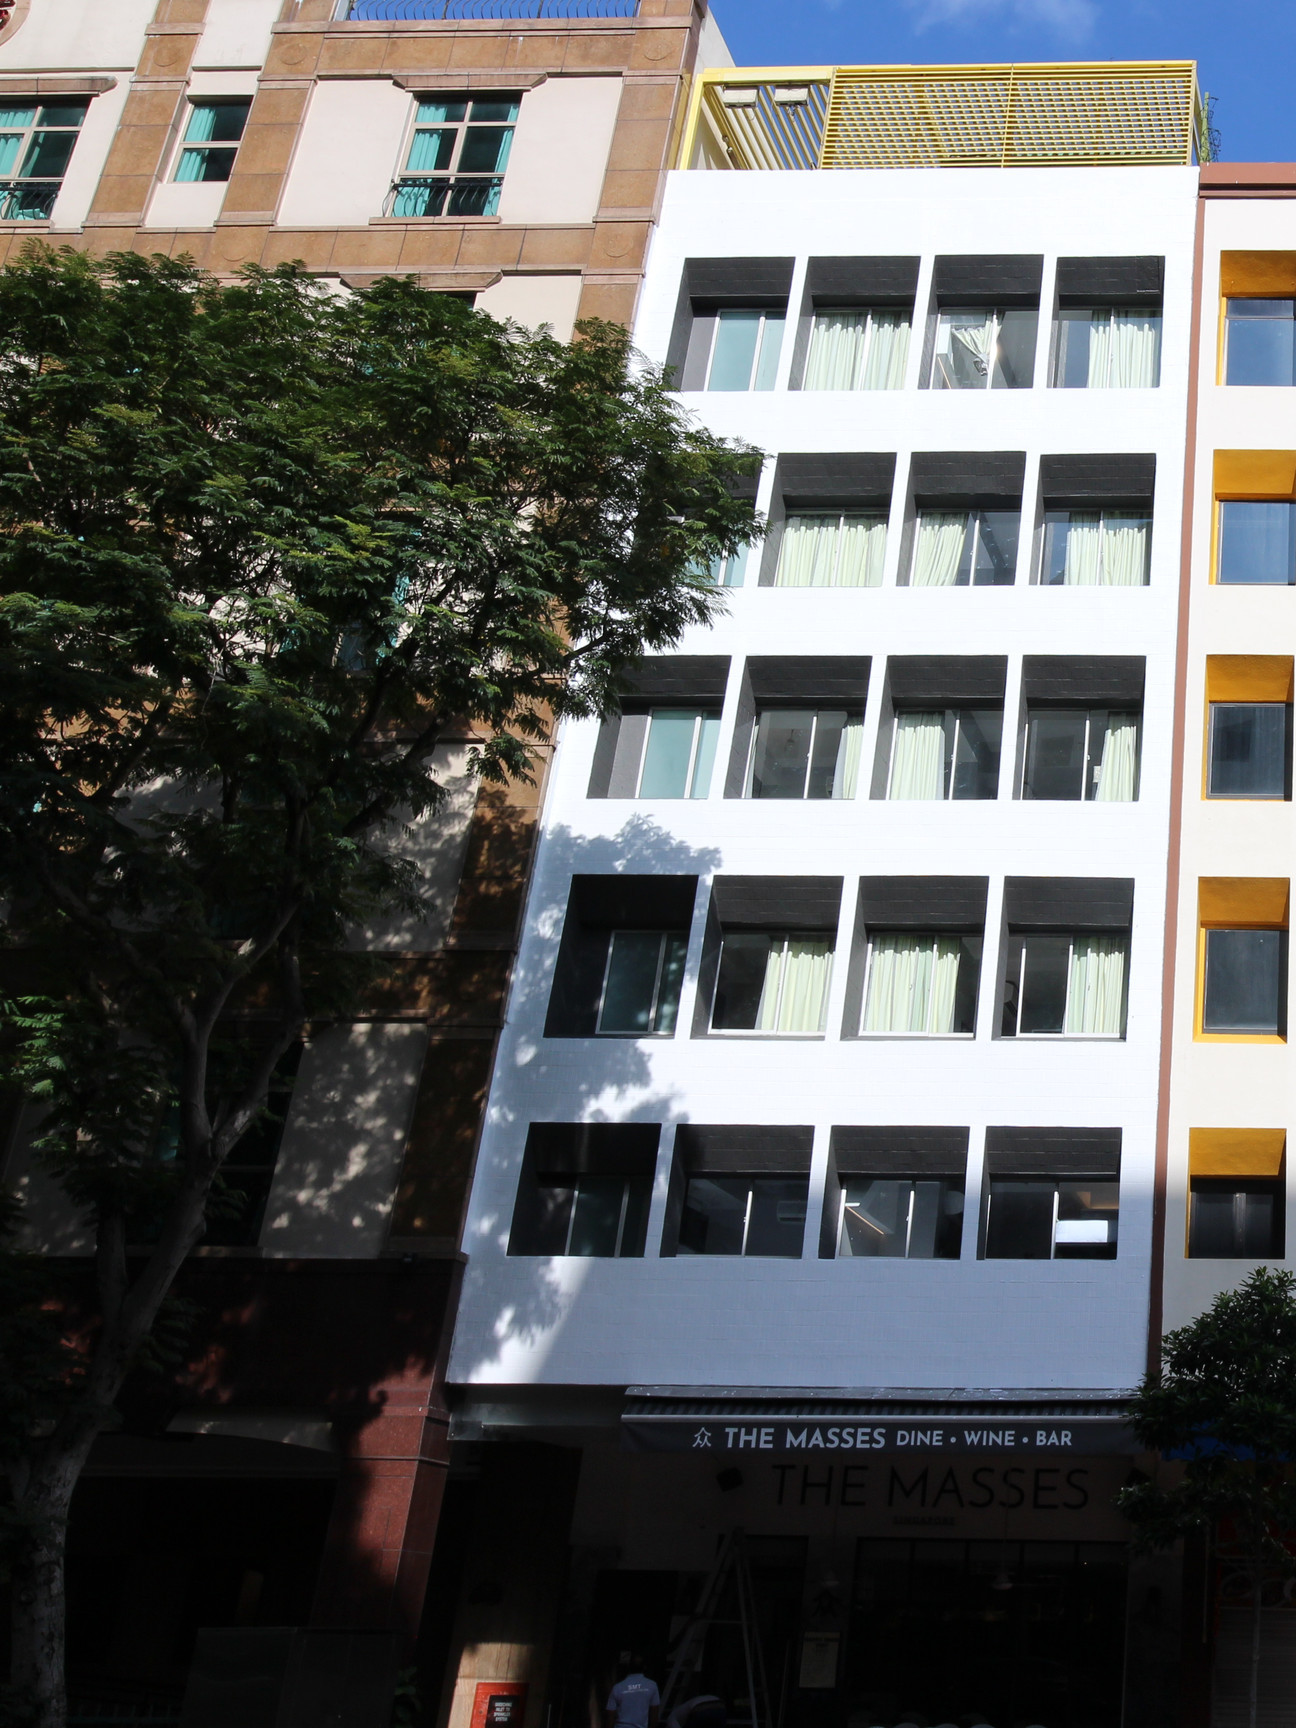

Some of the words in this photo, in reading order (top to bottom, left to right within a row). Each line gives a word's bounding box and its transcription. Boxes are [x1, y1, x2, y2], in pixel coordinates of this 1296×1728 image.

[725, 1427, 775, 1449] THE
[785, 1427, 887, 1449] MASSES
[896, 1430, 944, 1446] DINE
[963, 1430, 1016, 1446] WINE
[1035, 1430, 1072, 1446] BAR
[772, 1464, 869, 1506] THE
[887, 1465, 1089, 1510] MASSES
